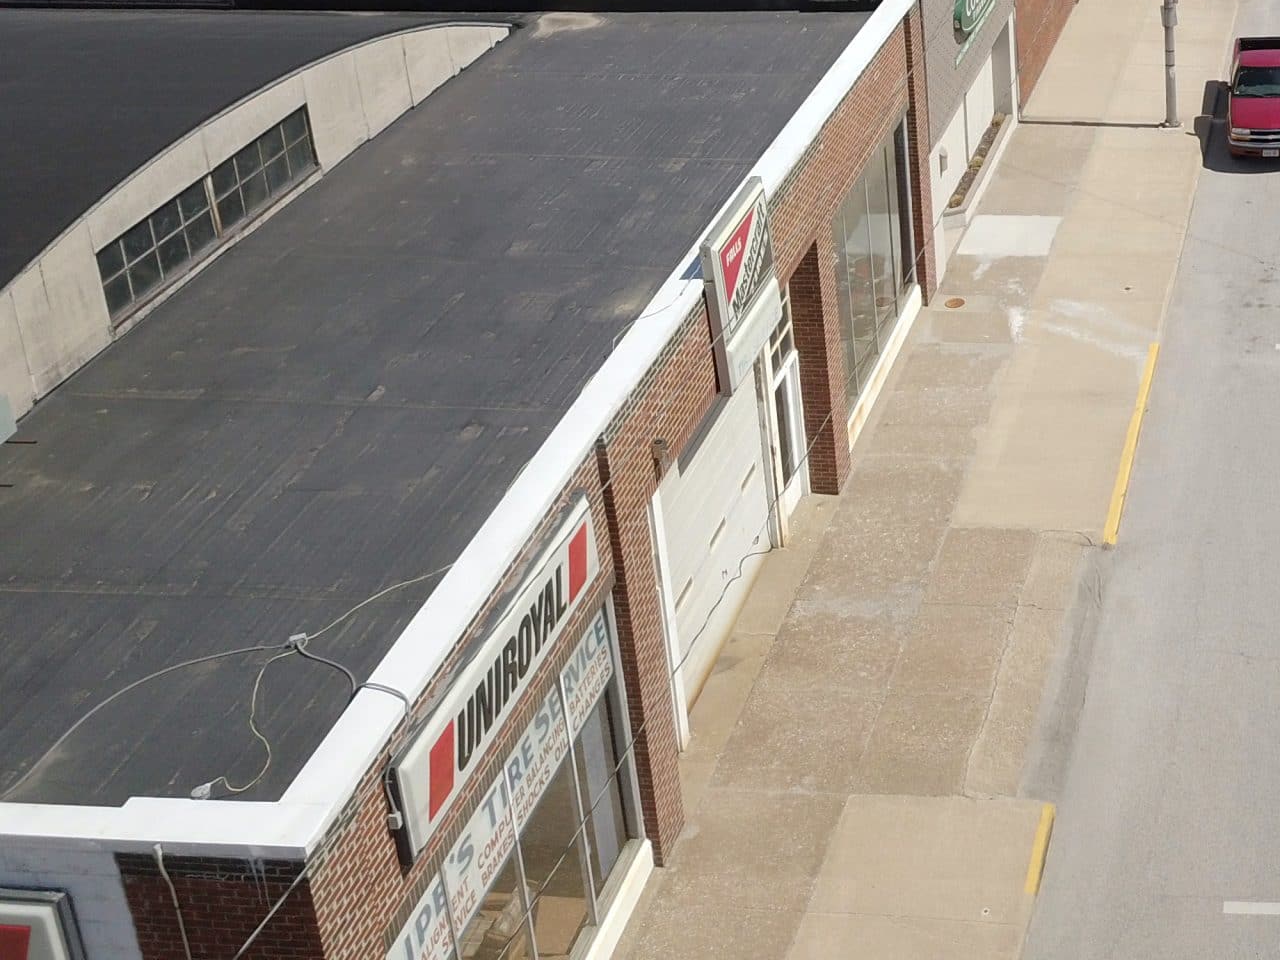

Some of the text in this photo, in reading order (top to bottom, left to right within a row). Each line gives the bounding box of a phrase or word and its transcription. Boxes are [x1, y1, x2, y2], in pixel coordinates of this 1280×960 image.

[725, 237, 742, 268] FALLS
[732, 202, 765, 321] Mastercraft
[457, 562, 568, 772] UNIROYAL
[482, 735, 535, 827] TIRE
[534, 615, 606, 745] SERVICE
[420, 875, 470, 960] ALIGNENT
[525, 716, 566, 786] BALANCING
[569, 645, 608, 715] BATTERIES
[480, 829, 516, 889] BRAKES
[516, 763, 551, 827] SHOCKS
[554, 740, 569, 764] OIL
[572, 662, 611, 733] CHANGES
